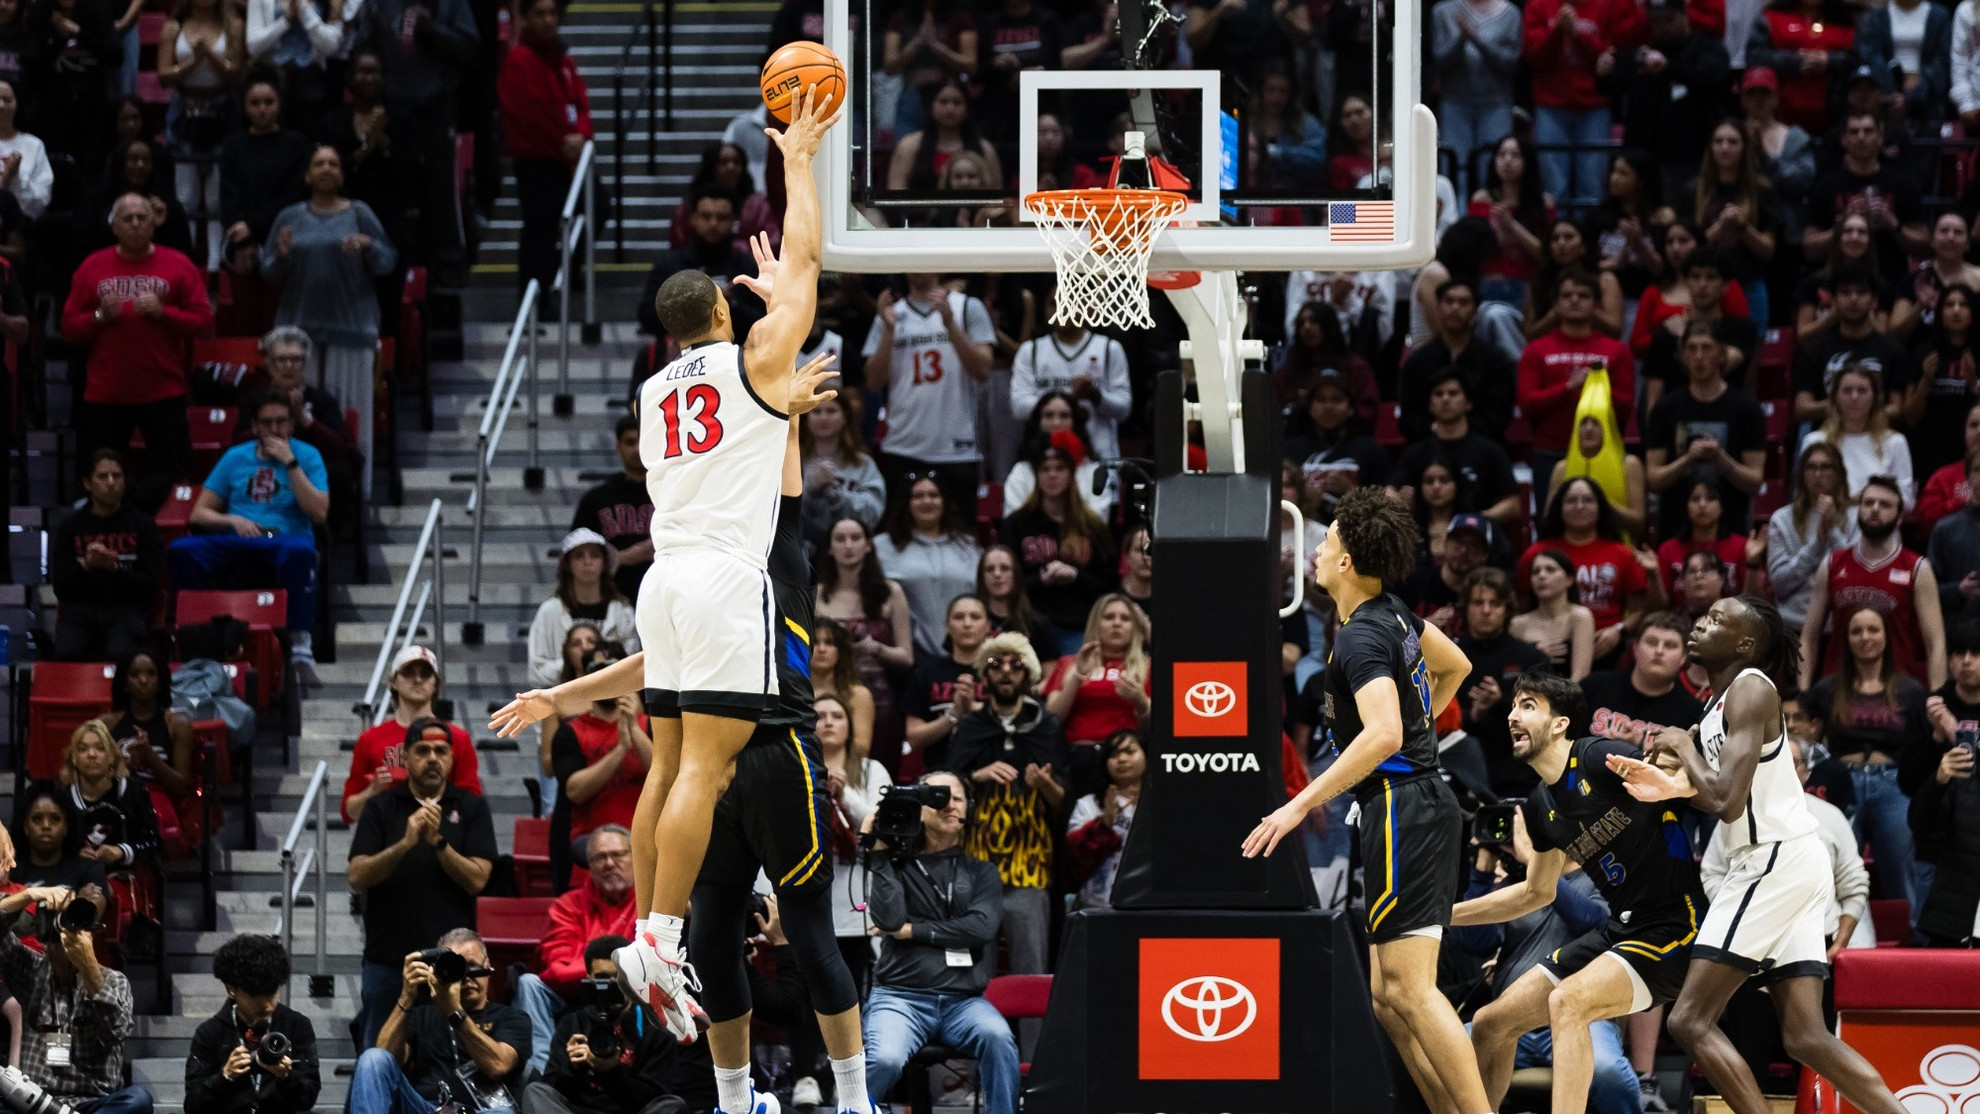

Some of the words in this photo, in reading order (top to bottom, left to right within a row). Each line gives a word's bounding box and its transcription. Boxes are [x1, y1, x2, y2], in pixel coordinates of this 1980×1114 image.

[764, 74, 802, 101] ELITE
[666, 355, 707, 381] LEDEE
[912, 350, 943, 385] 13
[658, 384, 724, 460] 13
[597, 503, 656, 540] SDS
[1160, 753, 1260, 773] TOYOTA
[1590, 806, 1633, 846] STATE
[1598, 851, 1627, 887] 5
